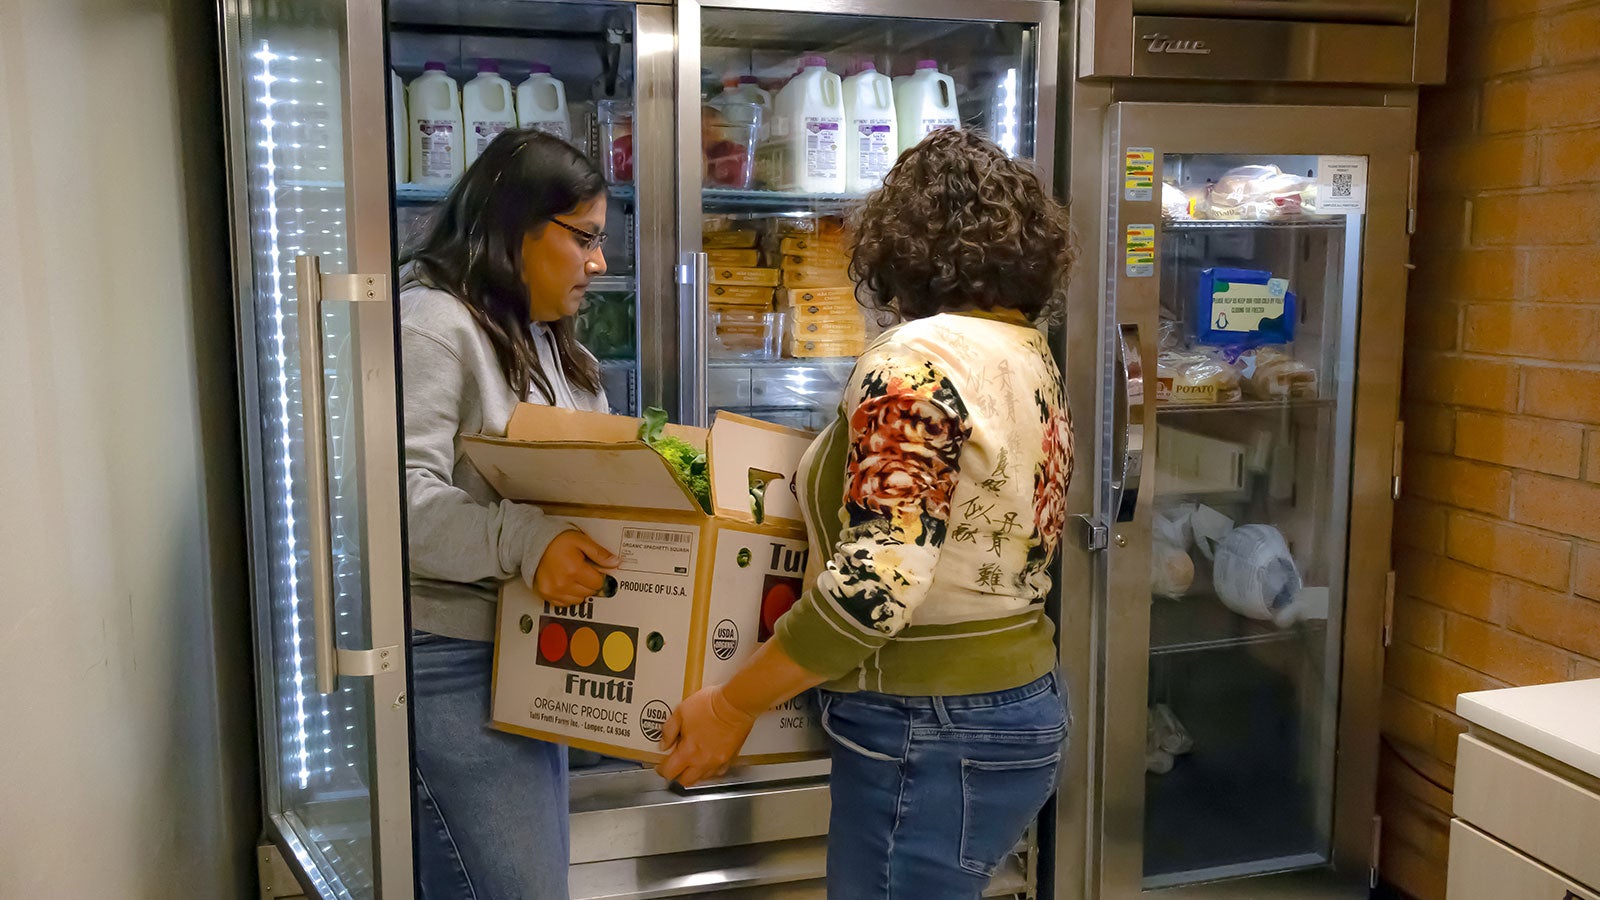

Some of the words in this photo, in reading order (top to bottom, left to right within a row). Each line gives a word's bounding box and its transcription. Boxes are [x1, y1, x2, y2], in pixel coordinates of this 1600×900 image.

[1176, 384, 1214, 396] POTATO
[620, 581, 653, 593] PRODUCE
[654, 583, 665, 595] OF
[665, 585, 688, 597] U.S.A.
[717, 628, 735, 638] USDA
[565, 673, 635, 704] Frutti
[534, 697, 579, 716] ORGANIC
[580, 705, 629, 725] PRODUCE
[646, 708, 667, 720] USDA
[529, 711, 541, 720] Tutti
[541, 713, 554, 722] Frutti
[606, 725, 614, 734] CA
[614, 727, 631, 738] 93436
[780, 716, 803, 729] SINCE
